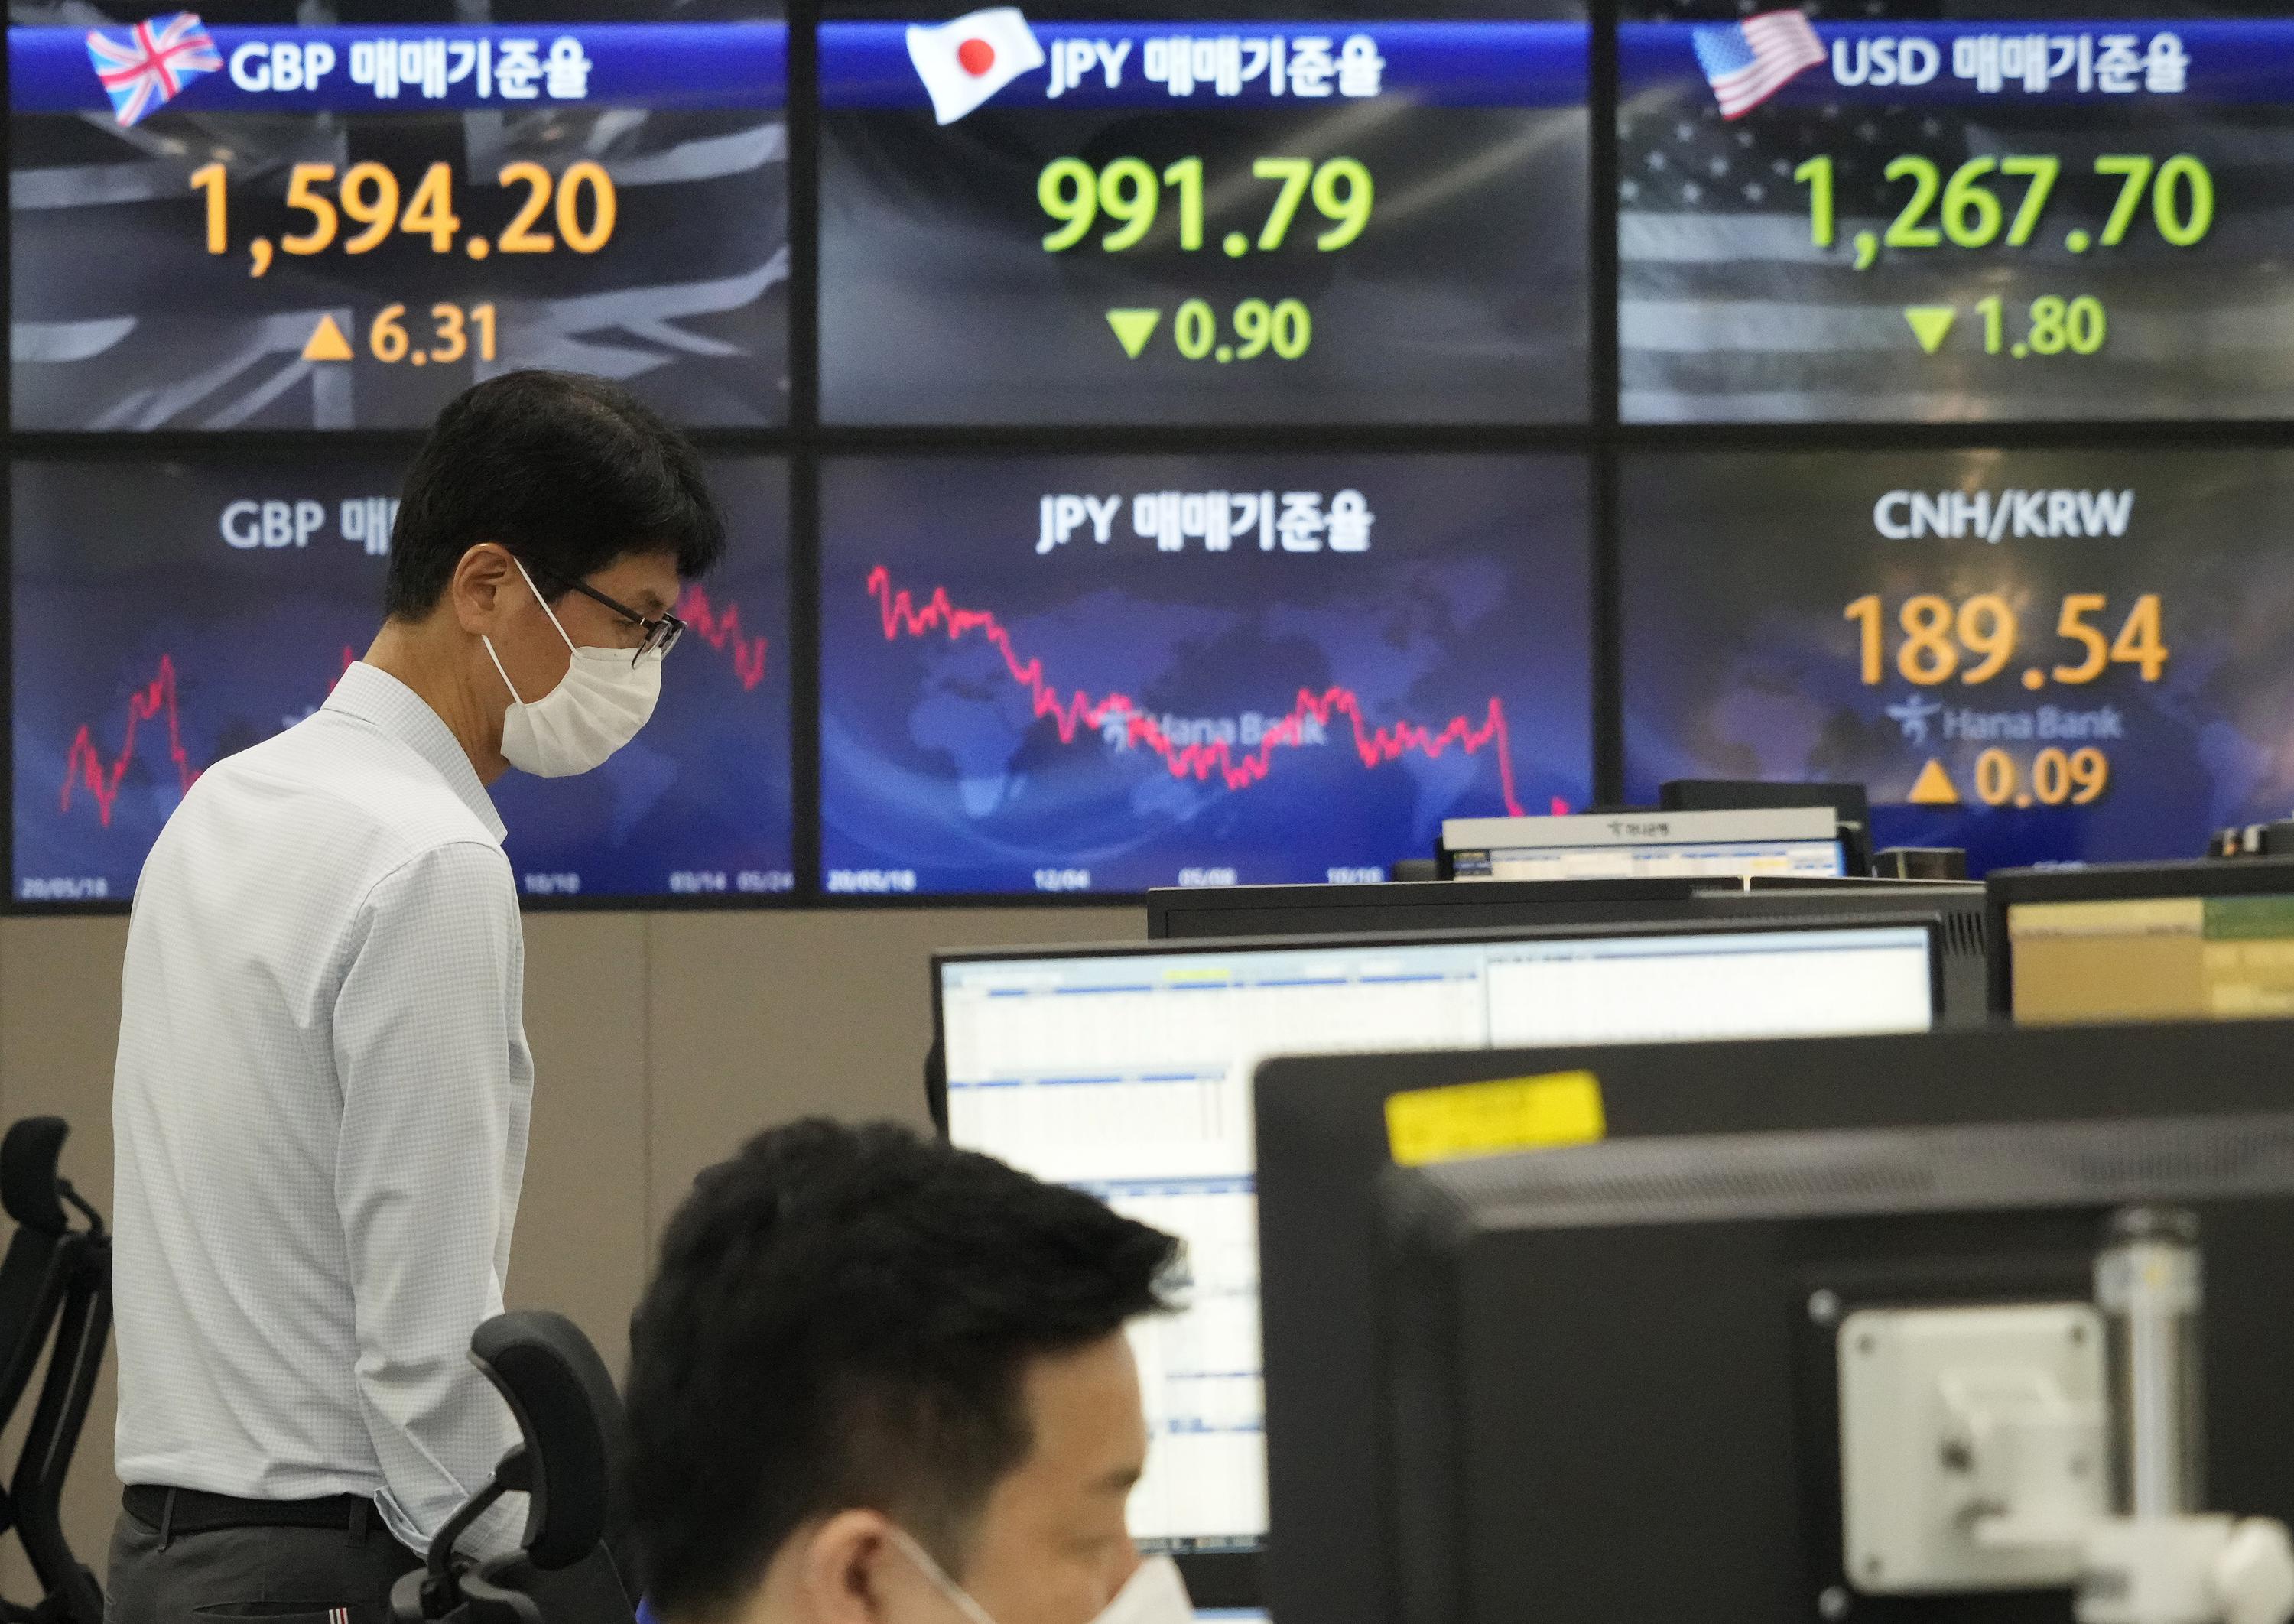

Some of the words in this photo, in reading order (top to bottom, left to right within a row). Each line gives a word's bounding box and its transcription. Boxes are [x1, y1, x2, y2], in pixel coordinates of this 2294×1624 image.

[229, 42, 336, 92] GBP
[350, 36, 592, 99] 매매기준율
[1046, 39, 1132, 99] JPY
[1144, 34, 1384, 98] 매매기준율
[1832, 37, 1940, 86] USD
[1953, 33, 2188, 93] 매매기준율
[192, 163, 617, 277] 1,594.20
[1038, 158, 1374, 258] 991.79
[1795, 156, 2214, 268] 1,267.70
[370, 304, 496, 365] 6.31
[1175, 299, 1312, 363] 0.90
[1978, 296, 2107, 359] 1.80
[221, 501, 325, 548] GBP
[1036, 495, 1121, 554] JPY
[1133, 490, 1373, 552] 매매기준율
[1873, 489, 2132, 544] CNH/KRW
[1844, 593, 2169, 690] 189.54
[1943, 707, 2033, 741] Hana
[2036, 704, 2121, 739] Bank
[1976, 749, 2109, 807] 0.09
